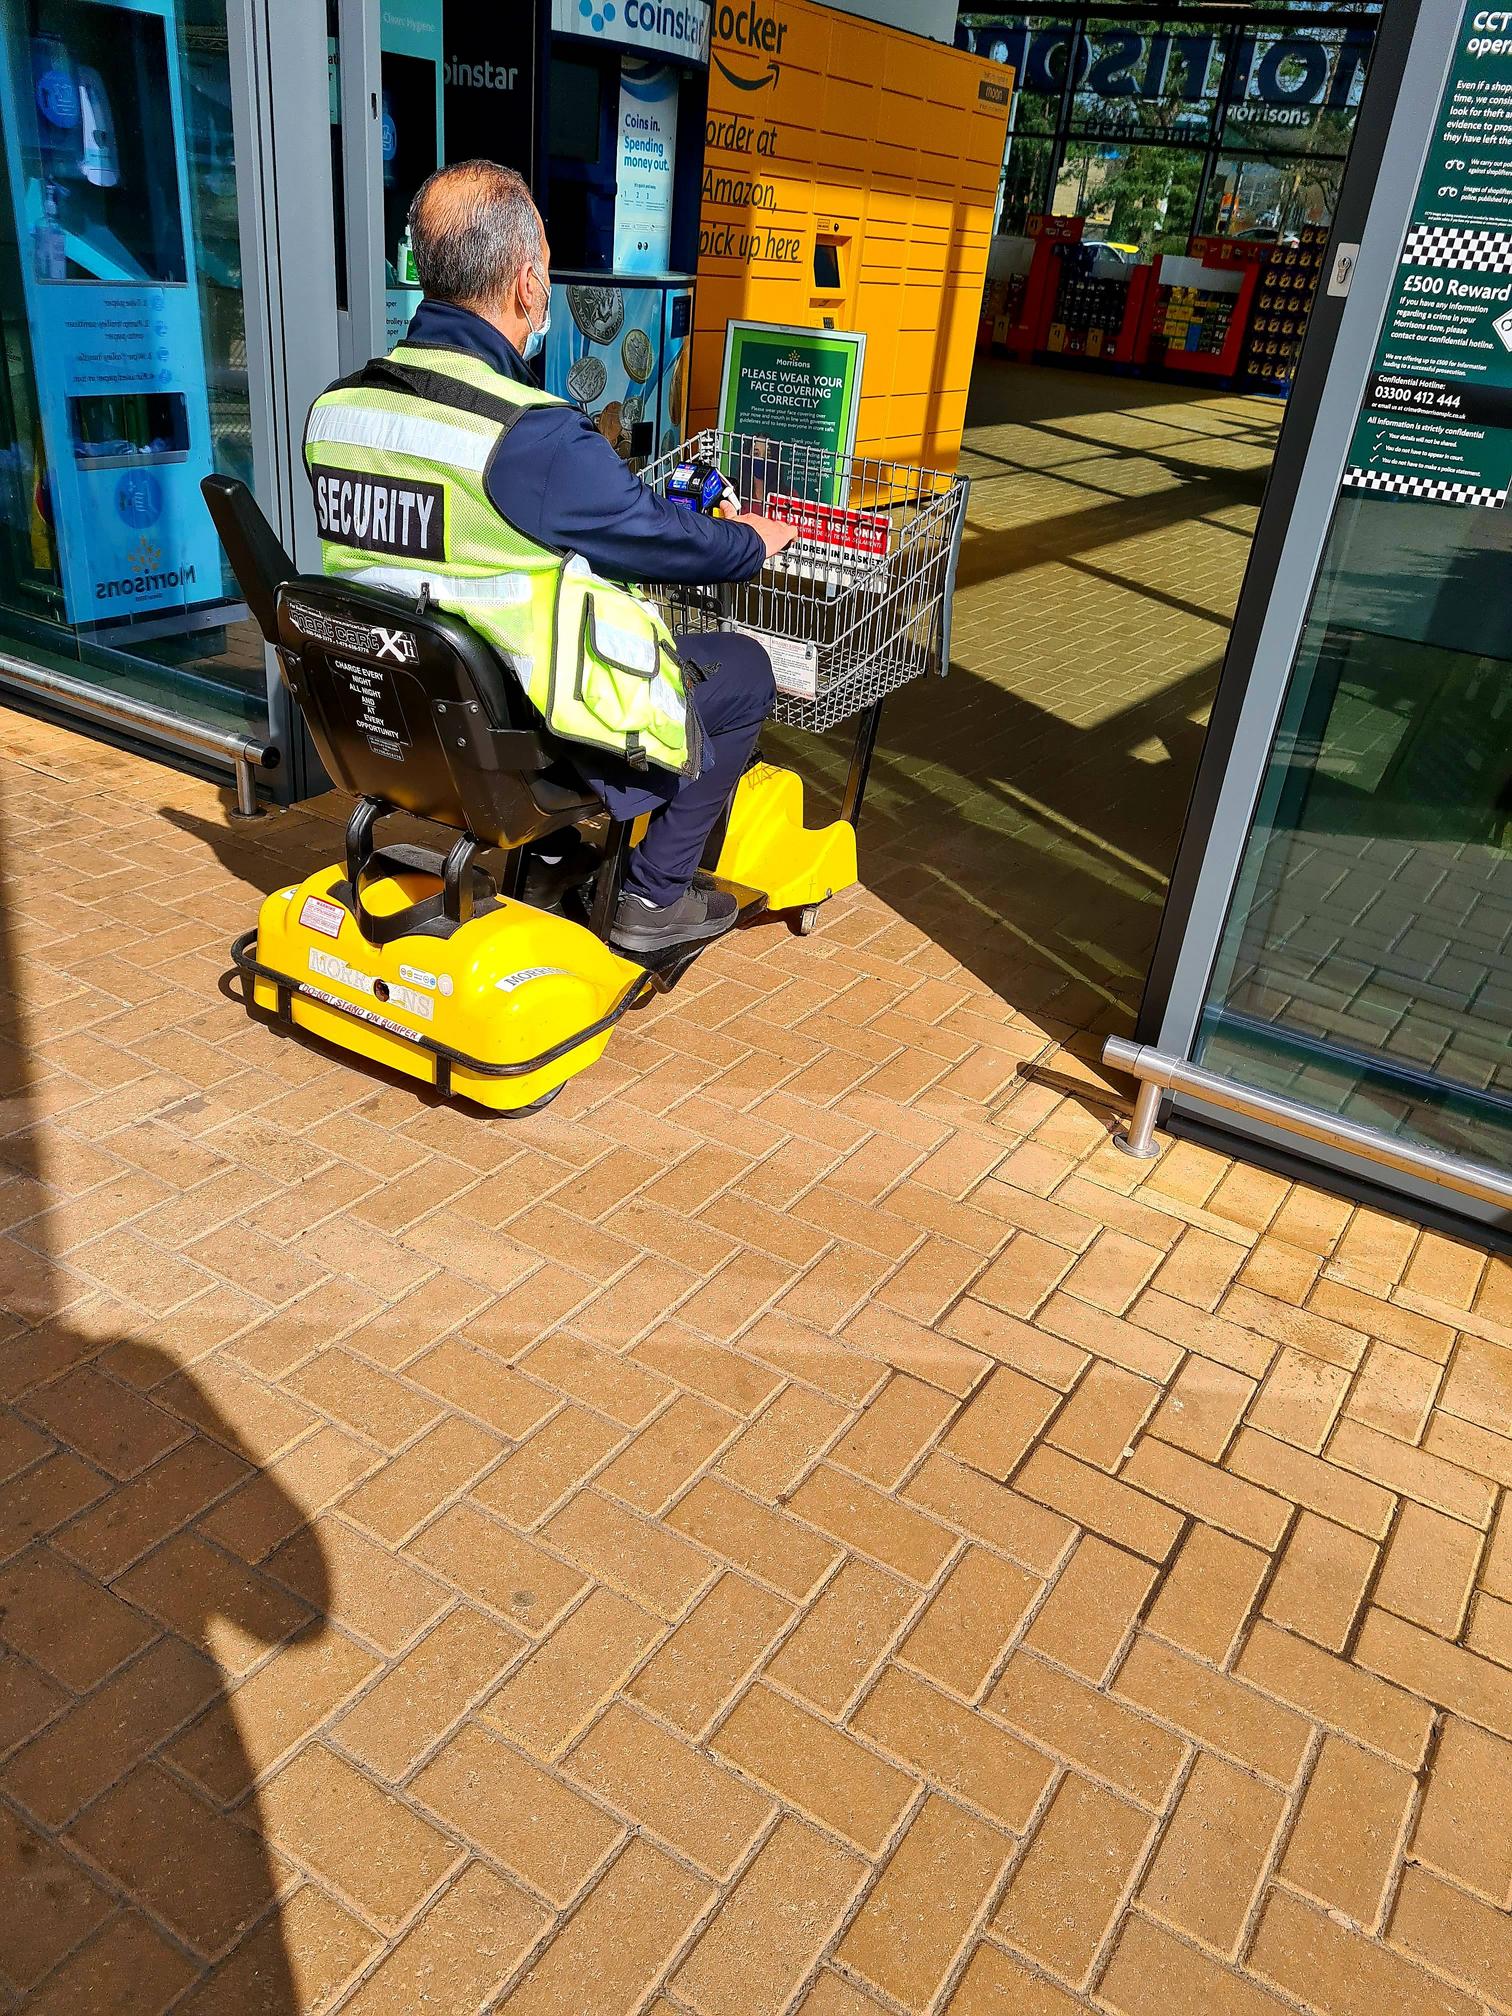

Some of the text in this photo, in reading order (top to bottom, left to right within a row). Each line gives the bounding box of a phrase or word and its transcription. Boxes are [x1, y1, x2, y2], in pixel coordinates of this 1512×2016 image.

[624, 0, 704, 45] coinstar
[1457, 80, 1476, 89] Even
[1477, 81, 1485, 89] if
[1454, 94, 1473, 104] time,
[1450, 106, 1504, 117] look for theft
[625, 113, 660, 132] Coins in.
[1447, 120, 1482, 129] evidence
[705, 116, 777, 156] order at
[1444, 131, 1461, 144] they
[1463, 133, 1481, 143] have
[1483, 134, 1498, 144] left
[624, 136, 664, 157] Spending
[624, 155, 670, 172] money out.
[702, 168, 777, 214] Amazon,
[700, 224, 800, 264] pick up here
[1403, 275, 1511, 301] £500 Reward
[1420, 299, 1434, 307] have
[1436, 302, 1448, 310] any
[1449, 302, 1488, 313] information
[1396, 309, 1426, 319] regarding
[1433, 313, 1451, 321] crime
[1393, 320, 1467, 334] Morrisons store, please
[1391, 332, 1416, 340] contact
[1429, 336, 1468, 346] confidential
[1469, 340, 1494, 349] hotline.
[776, 358, 810, 368] Morrisons
[1403, 355, 1422, 364] offering
[742, 368, 842, 388] PLEASE WEAR YOUR
[1378, 374, 1446, 390] Confidential Hotline:
[751, 381, 831, 398] FACE COVERING
[1375, 386, 1461, 408] 03300 412 444
[760, 394, 819, 408] CORRECTLY
[1367, 416, 1377, 424] All
[1377, 418, 1414, 429] information
[1422, 424, 1444, 434] strictly
[1445, 428, 1485, 439] confidential
[318, 476, 434, 549] SECURITY
[772, 511, 822, 529] IN-STORE
[828, 521, 849, 534] USE
[831, 550, 839, 558] IN
[335, 660, 383, 680] CHARGE EVERY
[352, 675, 371, 687] NIGHT
[350, 683, 381, 698] ALL NIGHT
[362, 696, 375, 705] AND
[364, 714, 384, 726] EVERY
[356, 720, 399, 739] OPPORTUNITY
[317, 989, 335, 1001] NOT
[335, 999, 364, 1016] STAND
[366, 1012, 380, 1022] ON
[381, 1019, 418, 1039] BUMPER
